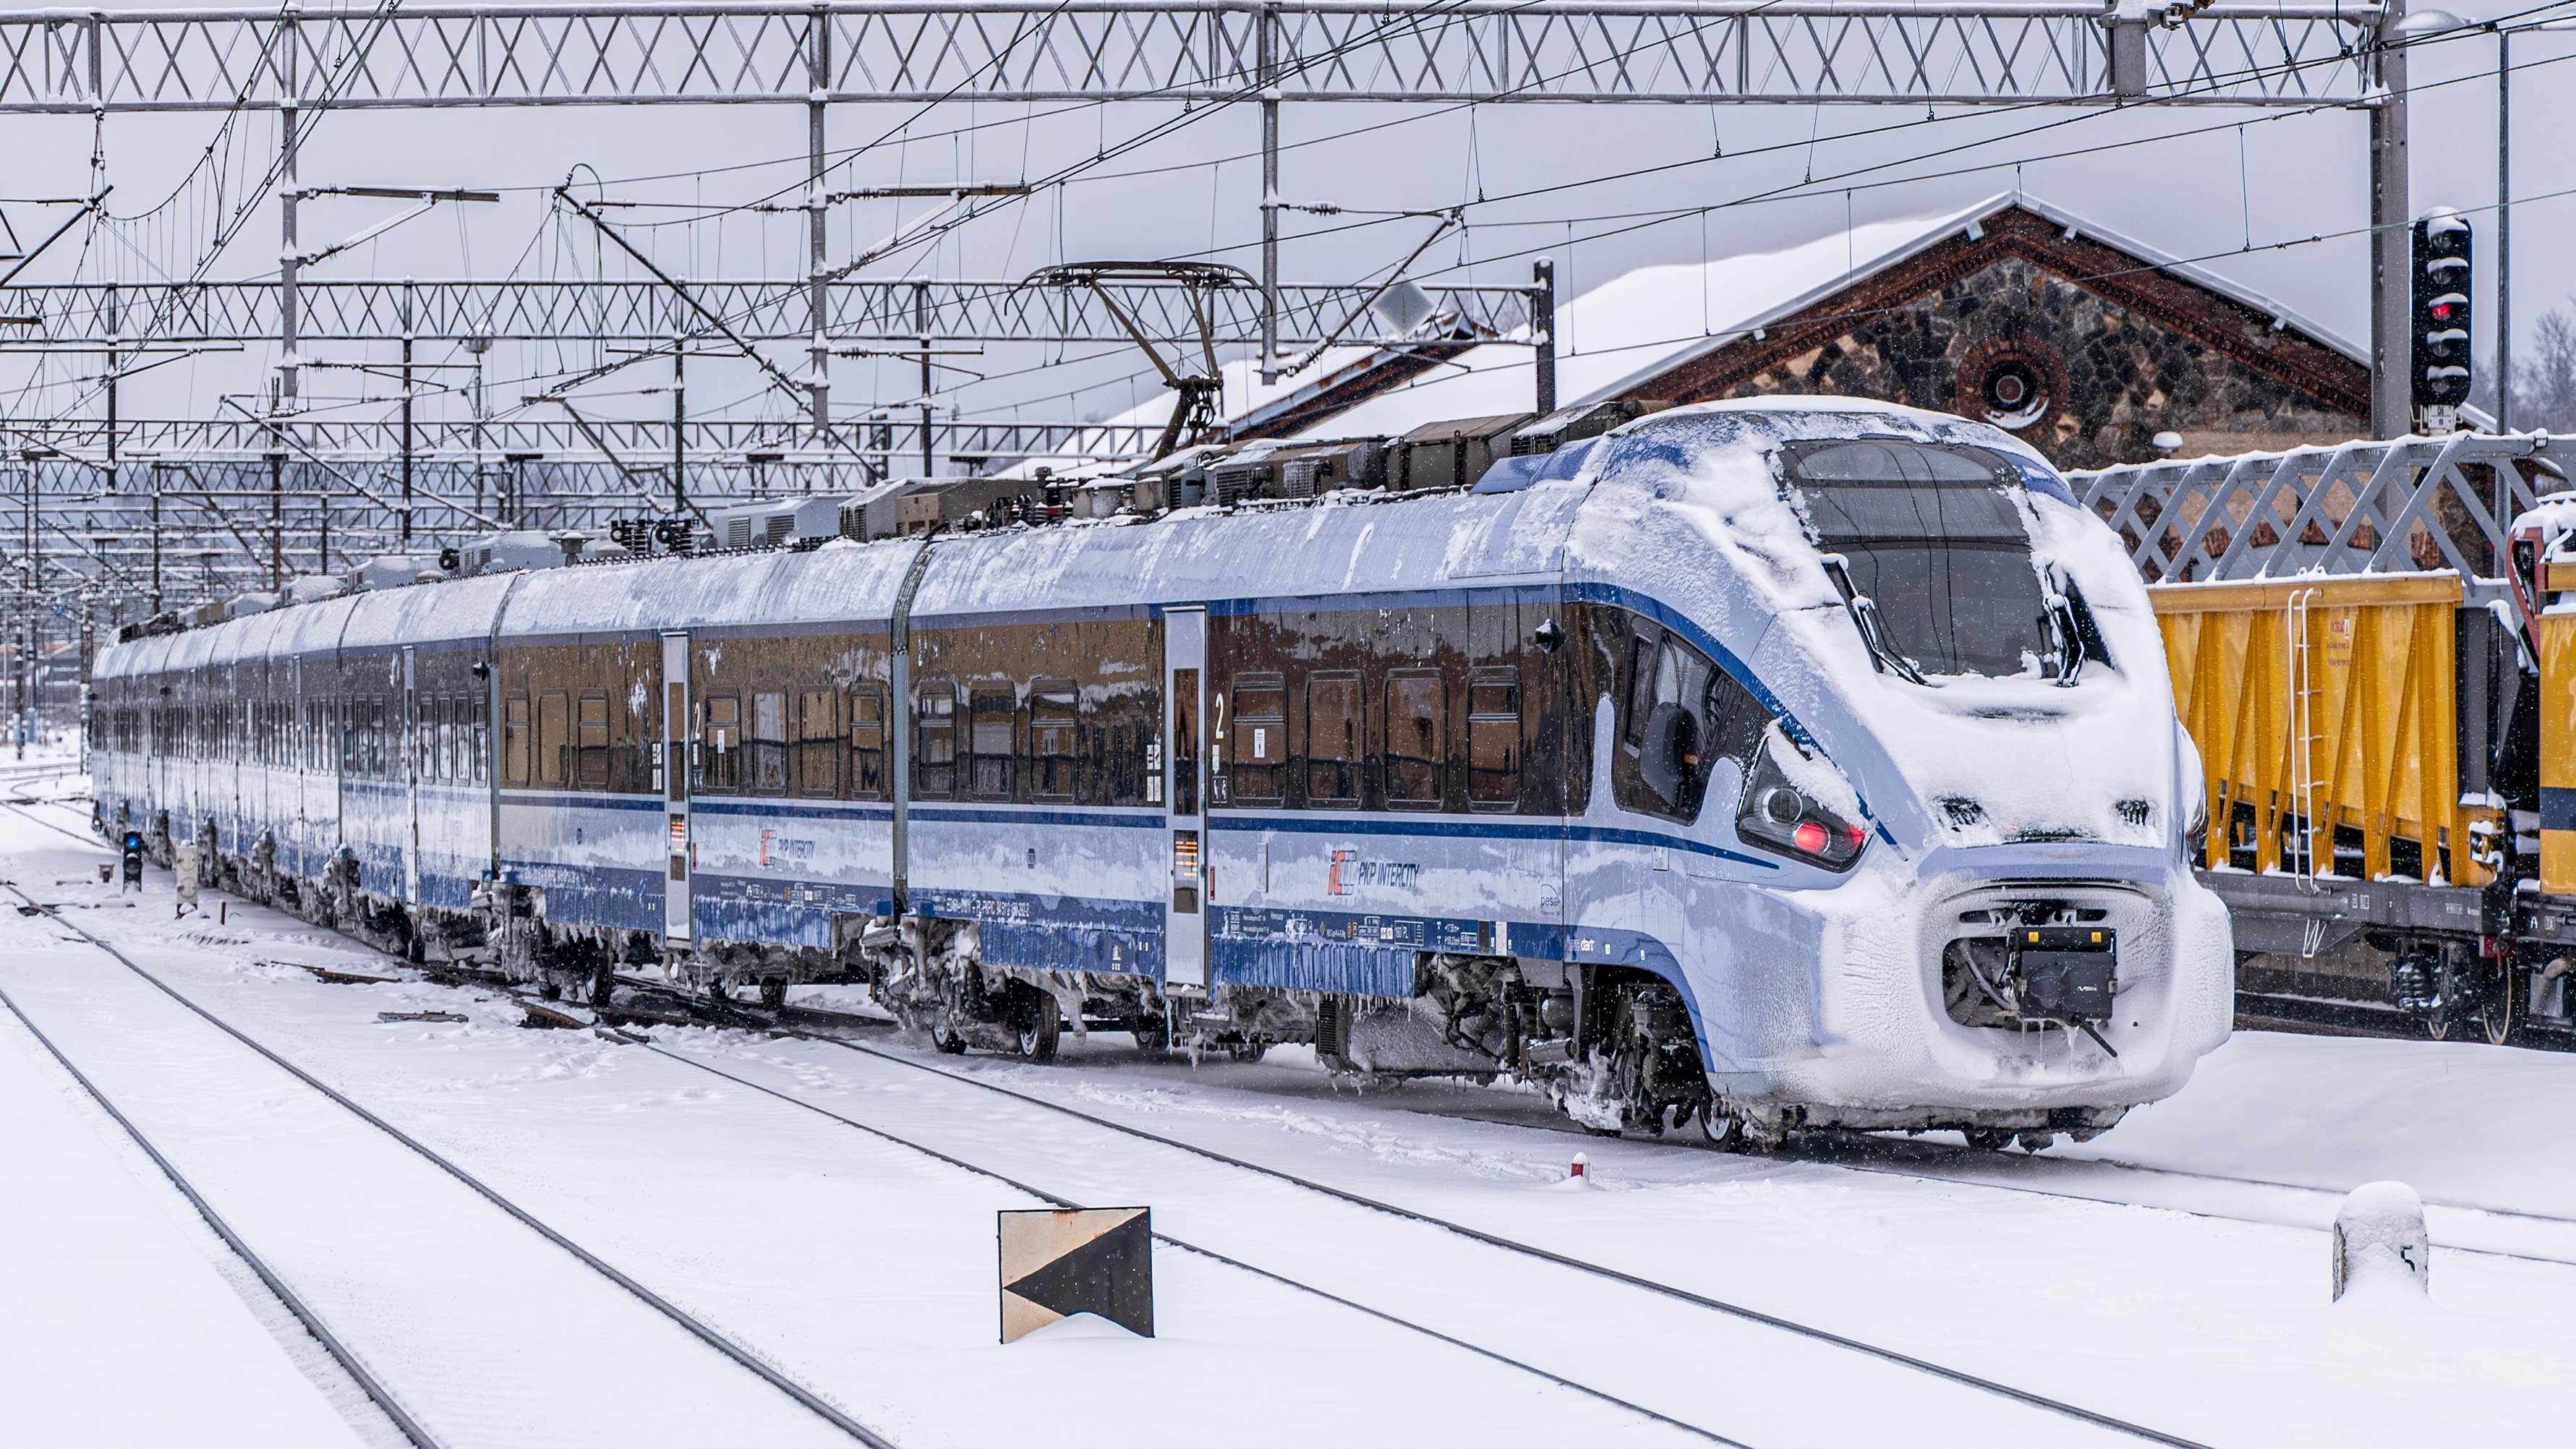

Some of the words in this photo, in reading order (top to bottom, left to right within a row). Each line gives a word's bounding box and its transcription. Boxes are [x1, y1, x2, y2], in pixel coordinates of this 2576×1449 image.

[694, 702, 700, 740] 2
[1216, 693, 1224, 739] 2
[789, 839, 815, 860] INTERCITY
[1359, 862, 1376, 885] PKP
[1378, 863, 1420, 887] INTERCITY
[1541, 897, 1558, 908] pesa
